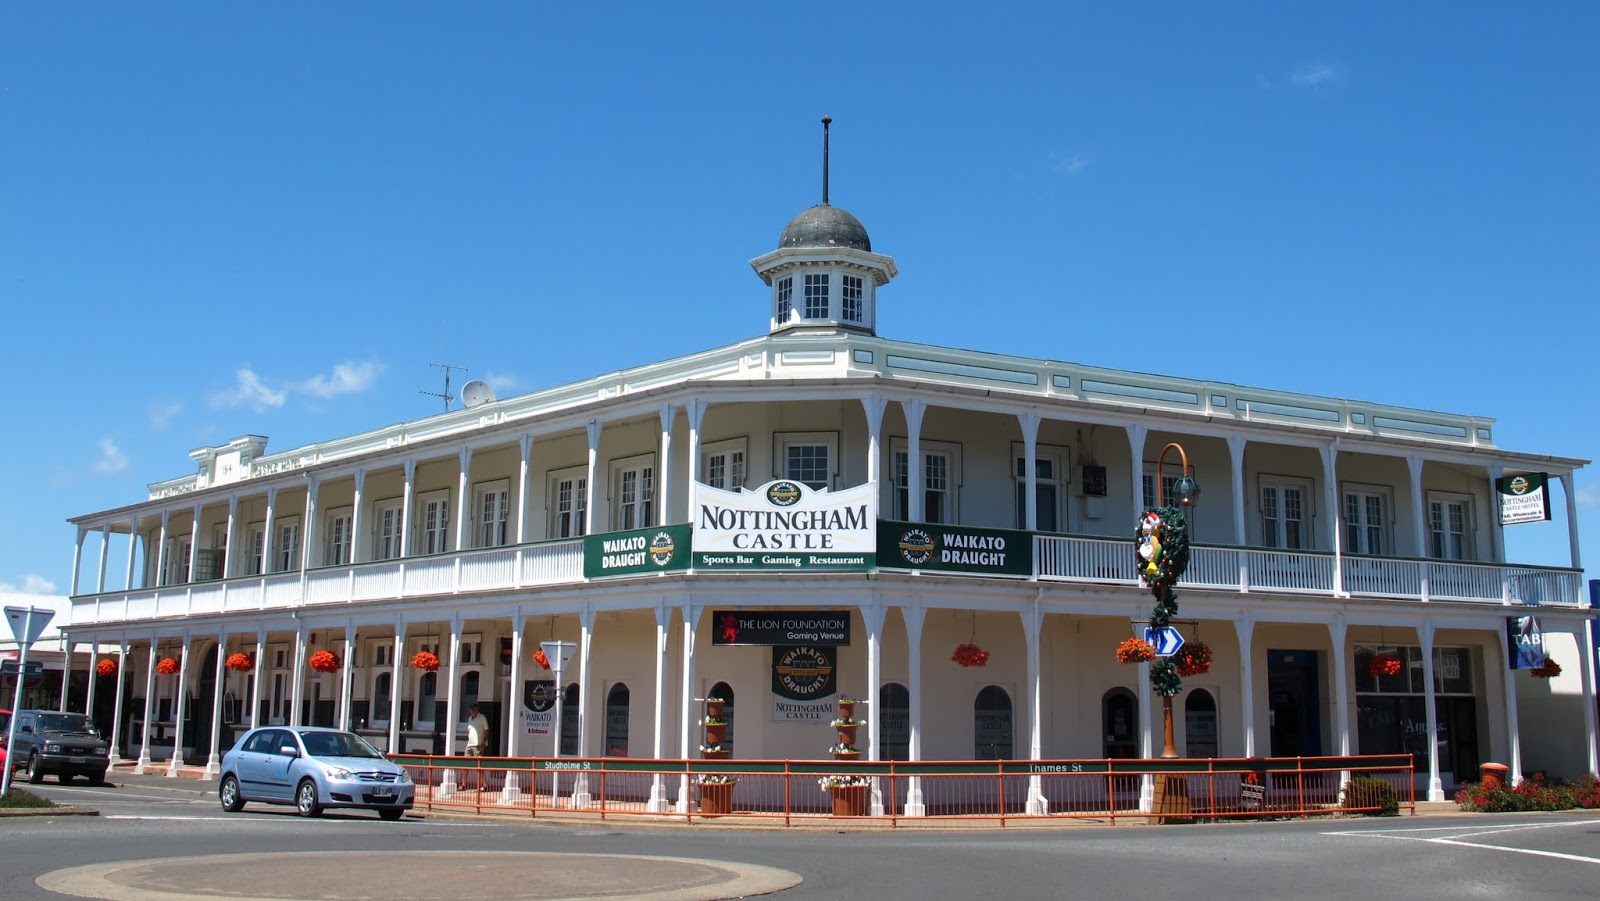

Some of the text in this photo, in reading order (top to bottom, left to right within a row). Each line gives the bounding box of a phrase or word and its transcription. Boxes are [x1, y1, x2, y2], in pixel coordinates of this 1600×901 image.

[700, 504, 868, 531] NOTTINGHAM
[653, 531, 671, 546] WAIKATO
[733, 533, 834, 549] CASTLE
[903, 529, 930, 543] WAIKATO
[943, 534, 1006, 550] WAIKATO
[603, 536, 646, 553] WAIKATO
[602, 552, 646, 569] DRAUGHT
[702, 555, 865, 567] Sports Bar Gaming Restaurant
[903, 549, 930, 565] DRAUGHT
[941, 550, 1006, 566] DRAUGHT
[739, 620, 845, 629] THE LION FOUNDATION
[786, 631, 845, 641] Gaming Venue
[1512, 633, 1541, 645] TAB
[783, 646, 825, 666] WAIKATO
[783, 675, 825, 694] DRAUGHT
[776, 702, 833, 713] NOTTINGHAM
[525, 713, 552, 722] WAIKATO
[544, 761, 591, 769] Studholme St
[1028, 763, 1082, 772] Thames St
